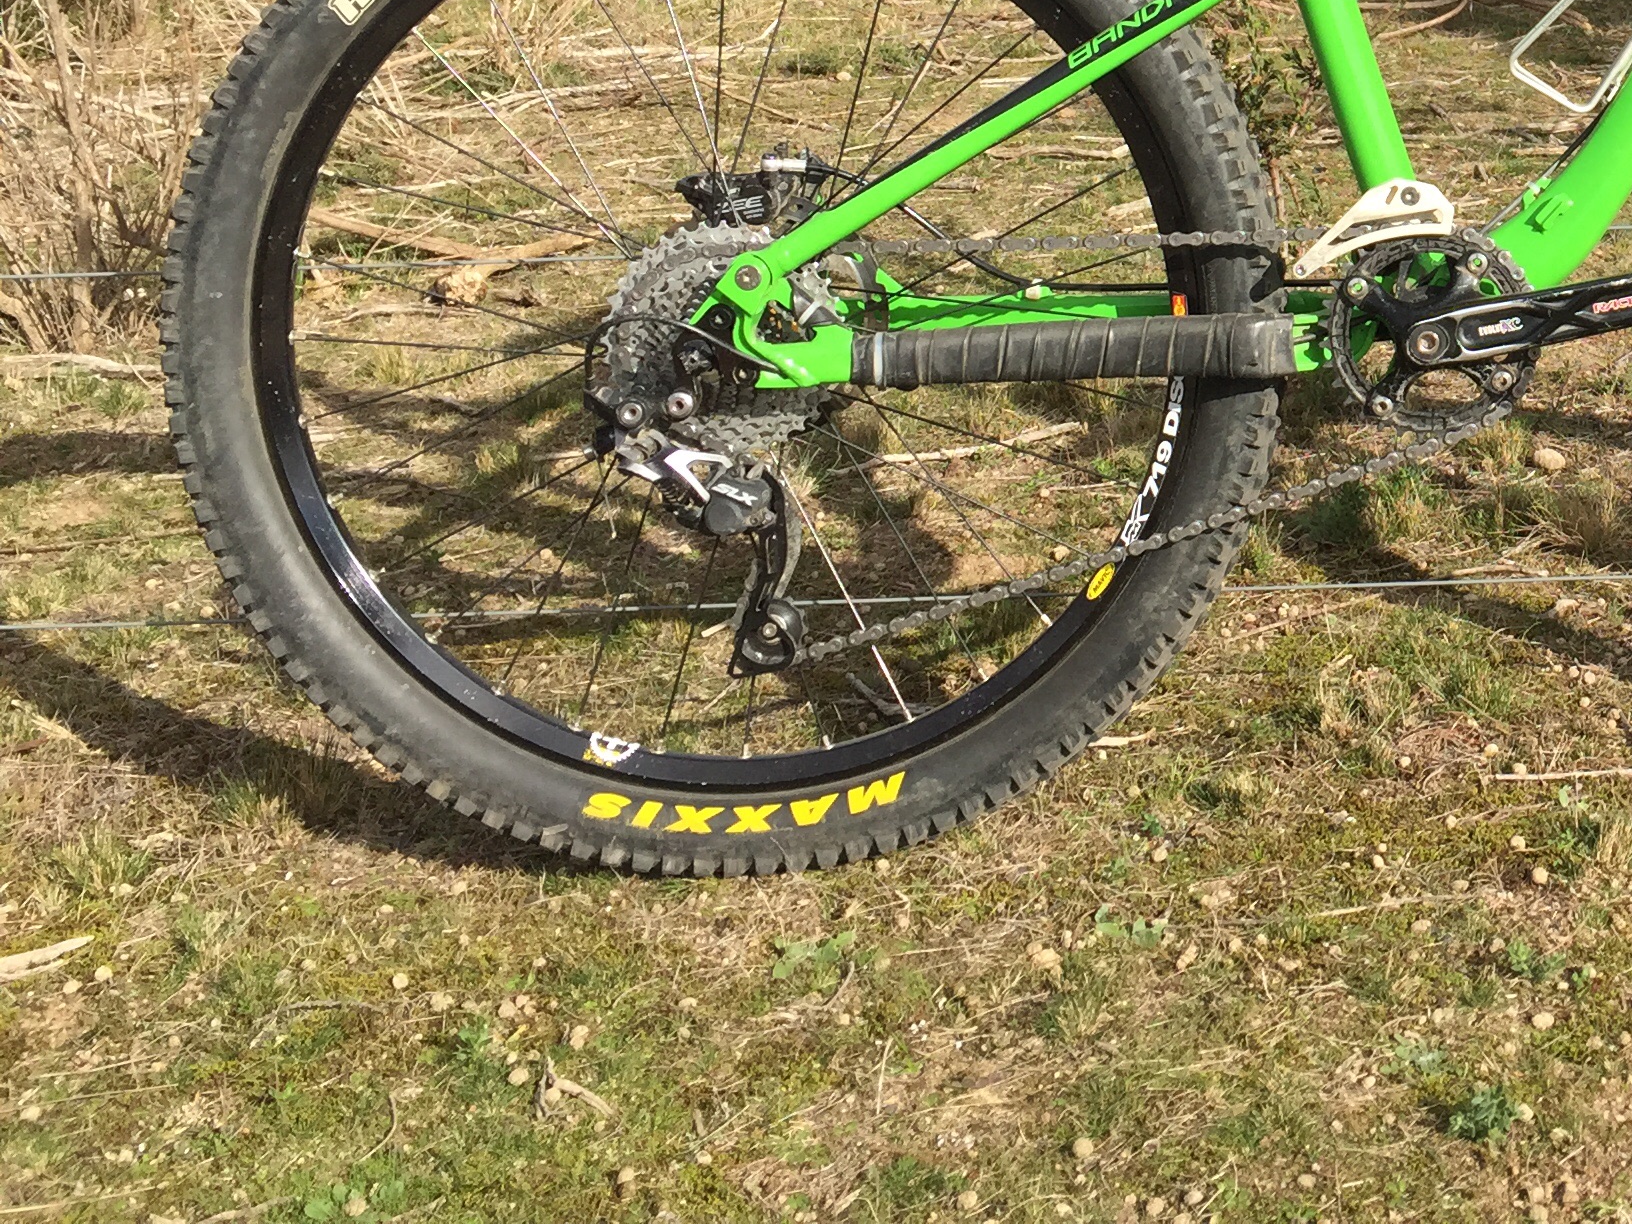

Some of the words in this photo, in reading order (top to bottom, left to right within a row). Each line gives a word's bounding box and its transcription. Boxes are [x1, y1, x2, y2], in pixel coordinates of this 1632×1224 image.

[1142, 440, 1173, 498] 719
[1162, 376, 1185, 437] DIS
[711, 483, 759, 507] SLX
[1092, 565, 1112, 594] MAVIC
[581, 771, 906, 834] MAXXIS
